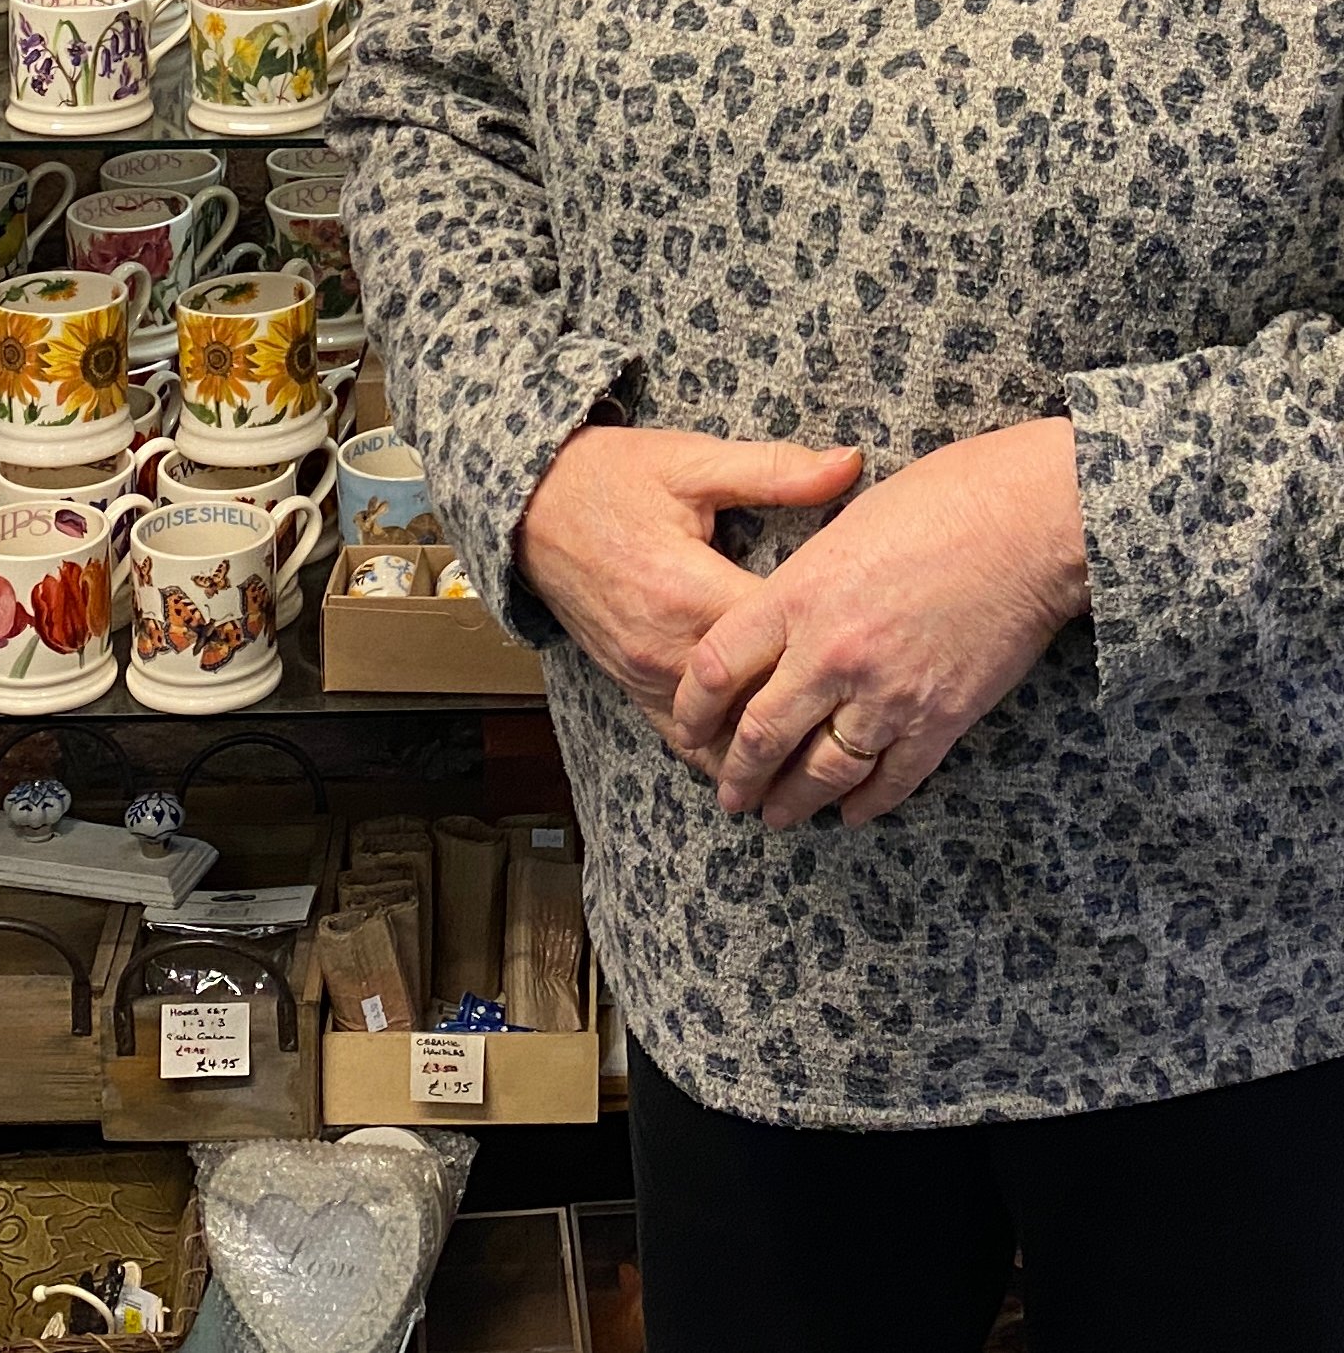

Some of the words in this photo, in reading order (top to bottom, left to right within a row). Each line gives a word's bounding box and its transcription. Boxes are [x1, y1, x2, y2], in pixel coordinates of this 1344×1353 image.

[422, 1048, 466, 1057] HANDLES
[196, 1056, 240, 1073] £4.95
[428, 1079, 474, 1097] £1.95
[273, 1236, 362, 1278] Love
